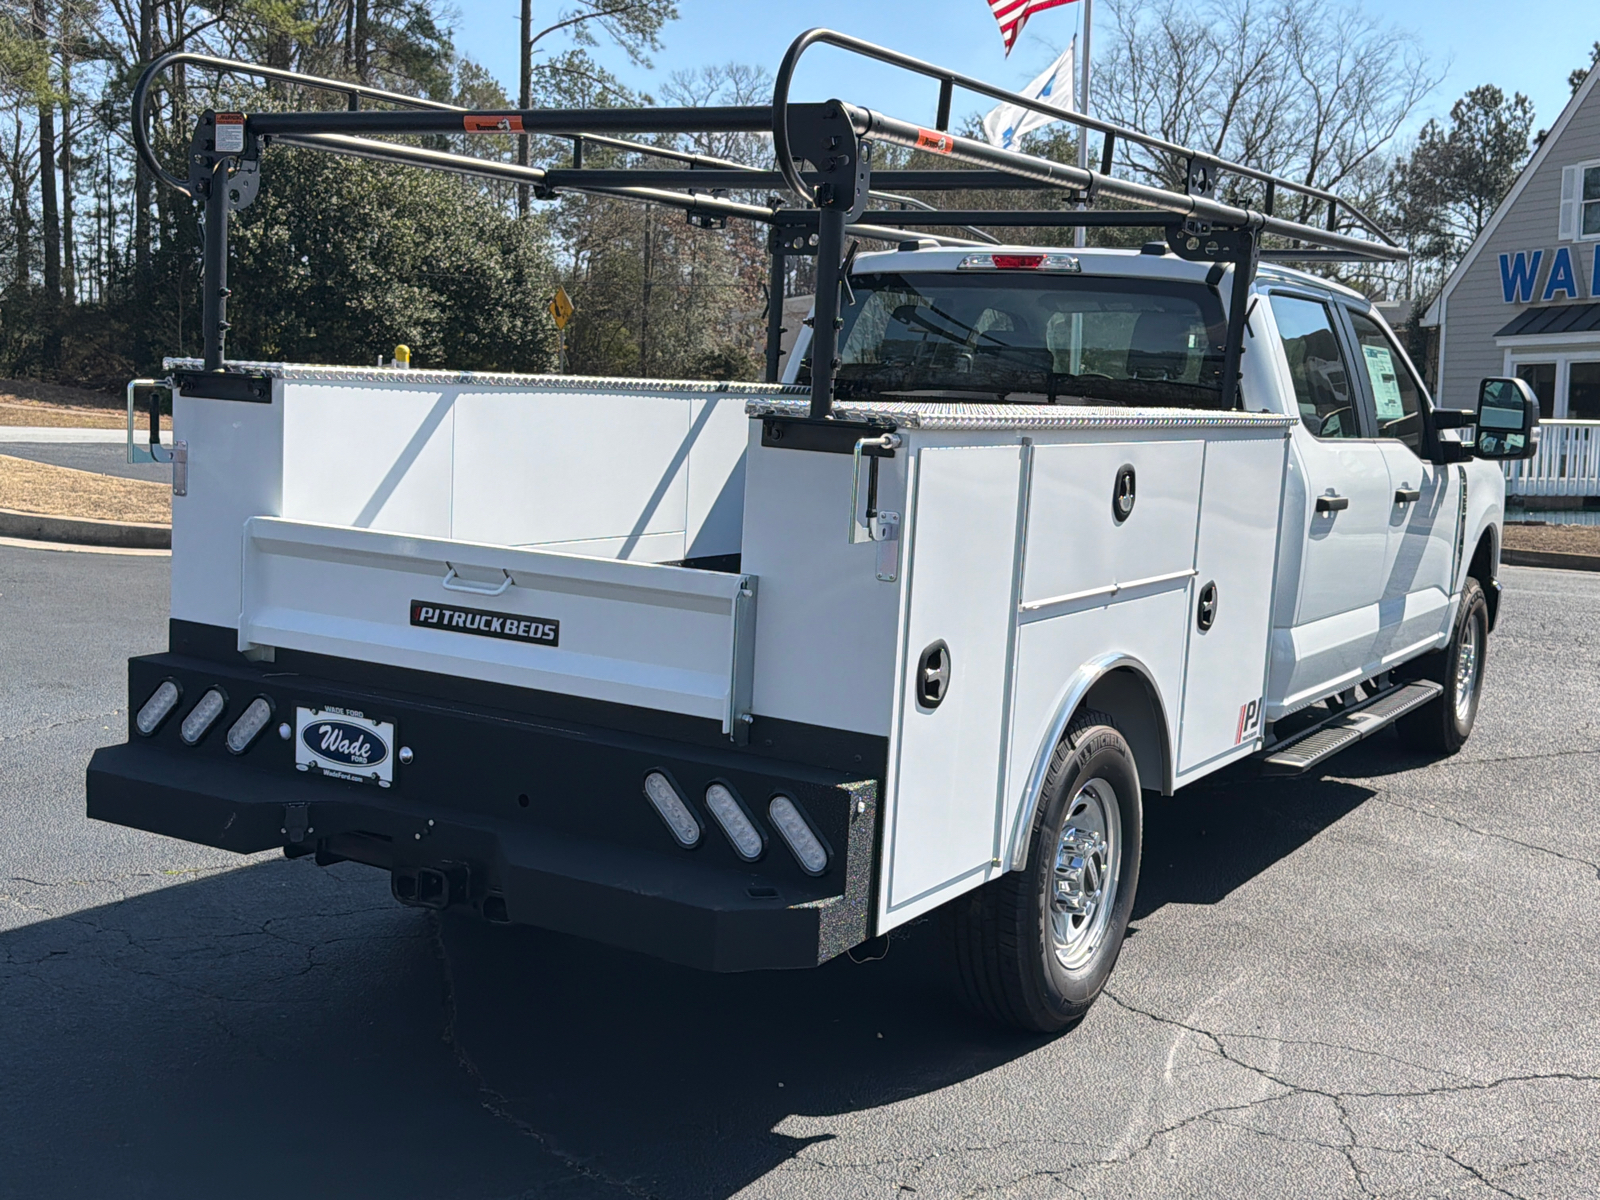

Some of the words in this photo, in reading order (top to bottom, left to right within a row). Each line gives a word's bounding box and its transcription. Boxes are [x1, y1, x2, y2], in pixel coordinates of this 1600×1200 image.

[419, 607, 440, 623] PJ
[324, 705, 345, 714] WADE
[345, 709, 364, 718] FORD
[1243, 697, 1262, 732] PJ
[318, 724, 372, 758] Wade
[1089, 732, 1126, 756] MICHELIN
[350, 755, 368, 764] FORD
[323, 769, 364, 783] WadeFord.com
